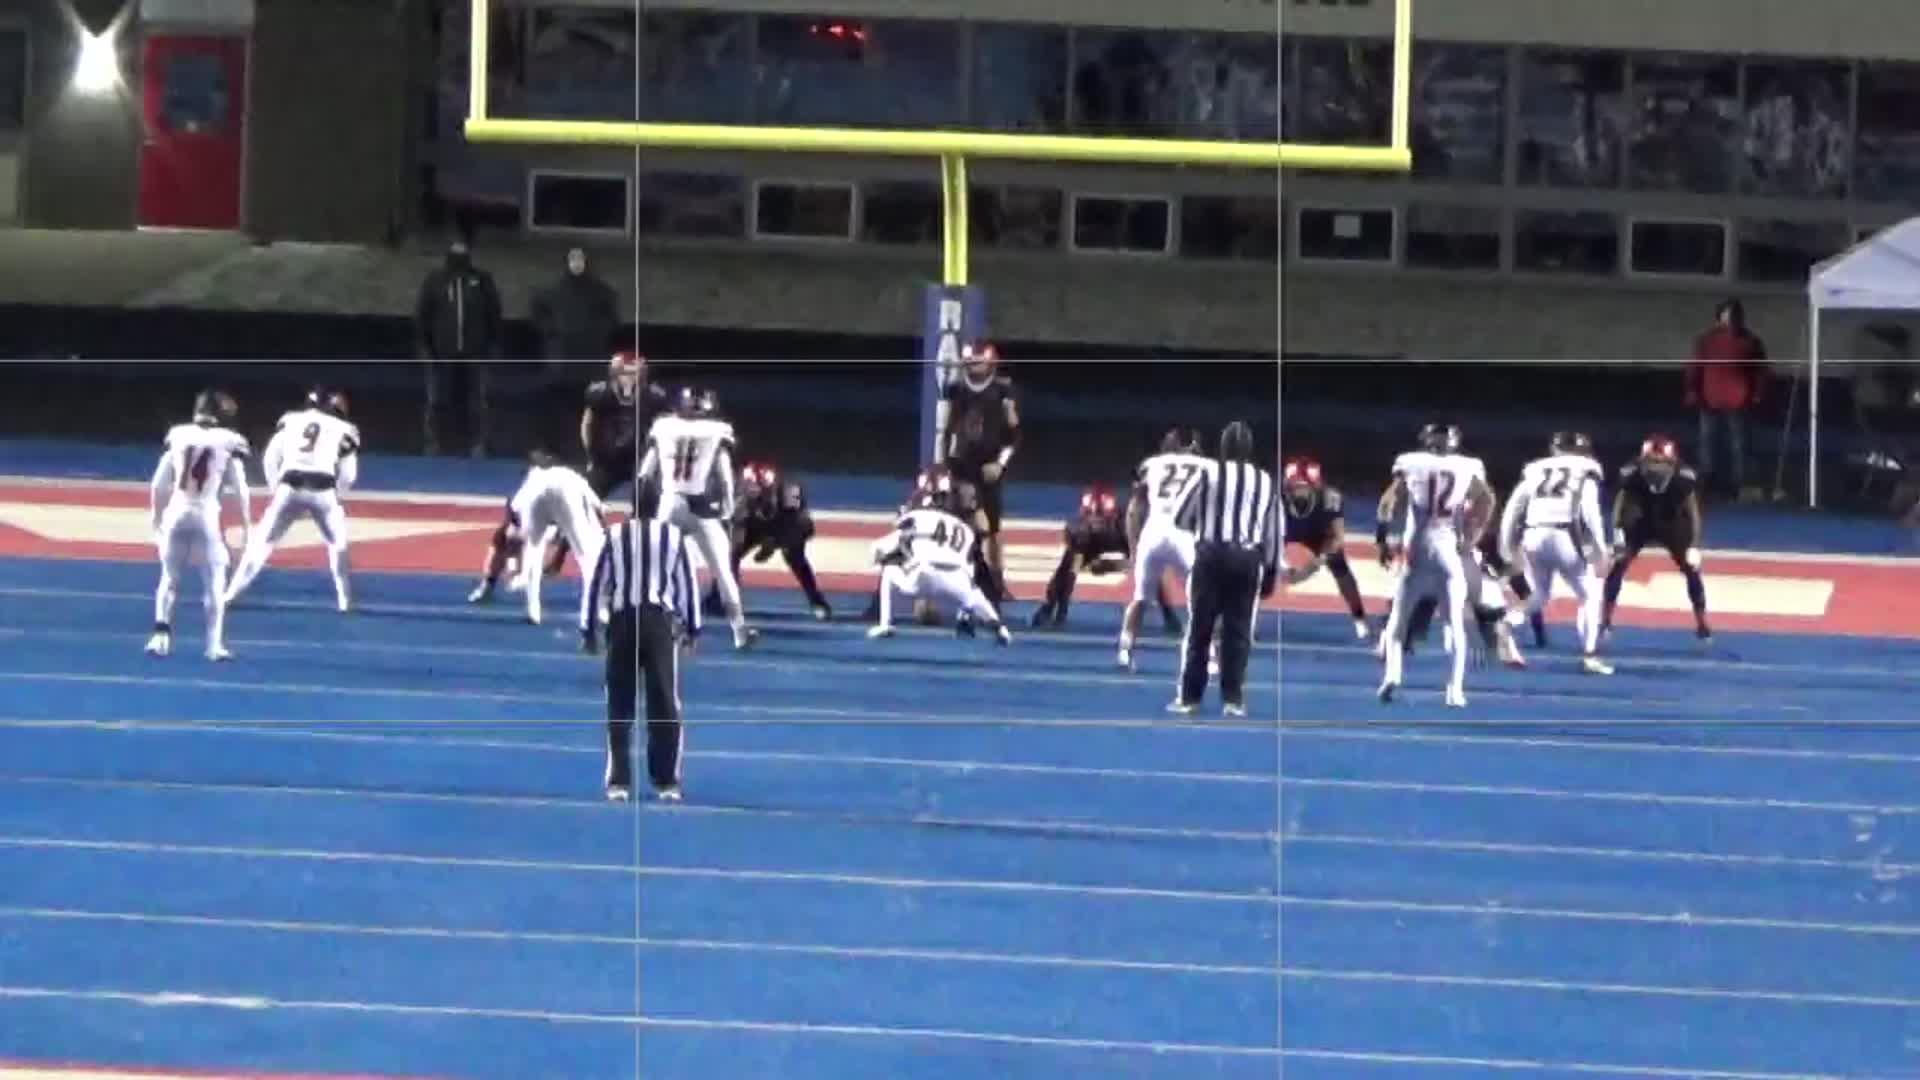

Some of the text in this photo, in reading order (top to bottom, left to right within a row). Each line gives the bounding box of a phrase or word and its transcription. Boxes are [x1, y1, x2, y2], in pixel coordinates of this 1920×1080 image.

[300, 422, 321, 453] 9
[1157, 463, 1199, 499] 27
[1427, 469, 1456, 518] 12
[1535, 467, 1572, 499] 22
[932, 519, 966, 553] 40
